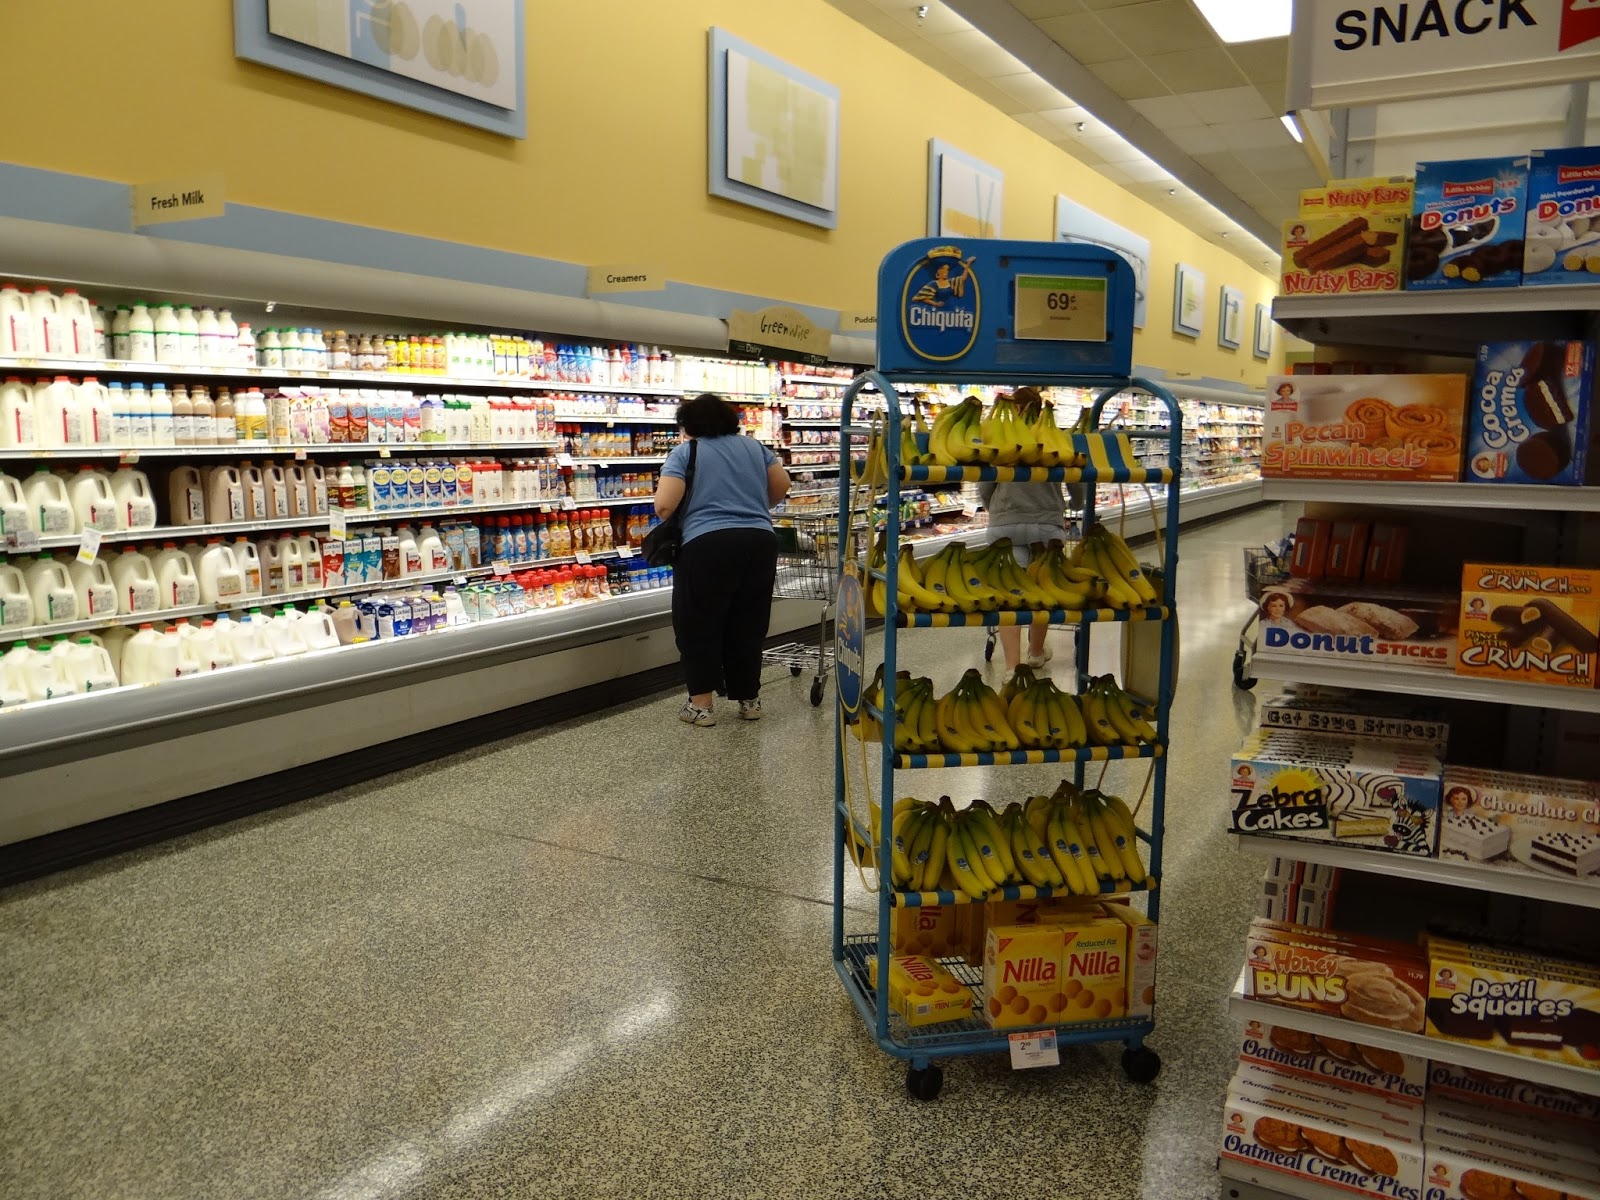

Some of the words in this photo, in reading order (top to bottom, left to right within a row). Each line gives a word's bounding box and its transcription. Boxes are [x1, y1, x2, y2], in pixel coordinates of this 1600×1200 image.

[1334, 0, 1538, 51] SNACK
[151, 194, 179, 210] Fresh
[182, 189, 204, 206] Milk
[1327, 188, 1371, 208] Nutty
[1373, 185, 1410, 206] Bars
[1421, 197, 1517, 231] Donuts
[606, 274, 647, 284] Creamers
[1283, 270, 1345, 294] Nutty
[1347, 267, 1399, 292] Bars
[910, 306, 974, 332] Chiquita
[745, 343, 762, 357] Dairy
[810, 354, 825, 367] Dairy
[1480, 370, 1508, 449] Cocoa
[1500, 367, 1529, 443] Cremes
[1284, 421, 1366, 444] Pecan
[1264, 441, 1427, 472] Spinwheels
[1478, 574, 1568, 594] CRUNCH
[1265, 627, 1374, 655] Donut
[1376, 643, 1448, 660] STICKS
[1461, 646, 1589, 677] CRUNCH
[1267, 710, 1302, 726] Get
[1308, 714, 1357, 732] Some
[1363, 719, 1445, 739] Stripes!
[1231, 785, 1323, 811] Zebra
[1480, 795, 1577, 822] Chocolate
[1237, 808, 1324, 832] Cakes
[919, 904, 942, 931] lla
[1075, 939, 1106, 949] Reduced
[1107, 938, 1117, 946] Fat
[895, 956, 934, 982] Nilla
[1002, 957, 1056, 983] Nilla
[1068, 951, 1121, 977] Nilla
[1273, 949, 1339, 978] Honey
[1255, 970, 1348, 1004] BUNS
[1471, 978, 1536, 999] Devil
[1450, 992, 1574, 1021] Squares
[1242, 1039, 1316, 1075] Oatmeal
[1319, 1058, 1377, 1086] Creme
[1381, 1071, 1424, 1098] Pies
[1432, 1067, 1515, 1100] Oatmeal
[1518, 1084, 1583, 1115] Creme
[1224, 1134, 1303, 1170] Oatmeal
[1306, 1156, 1368, 1187] Creme
[1372, 1173, 1420, 1200] Pies
